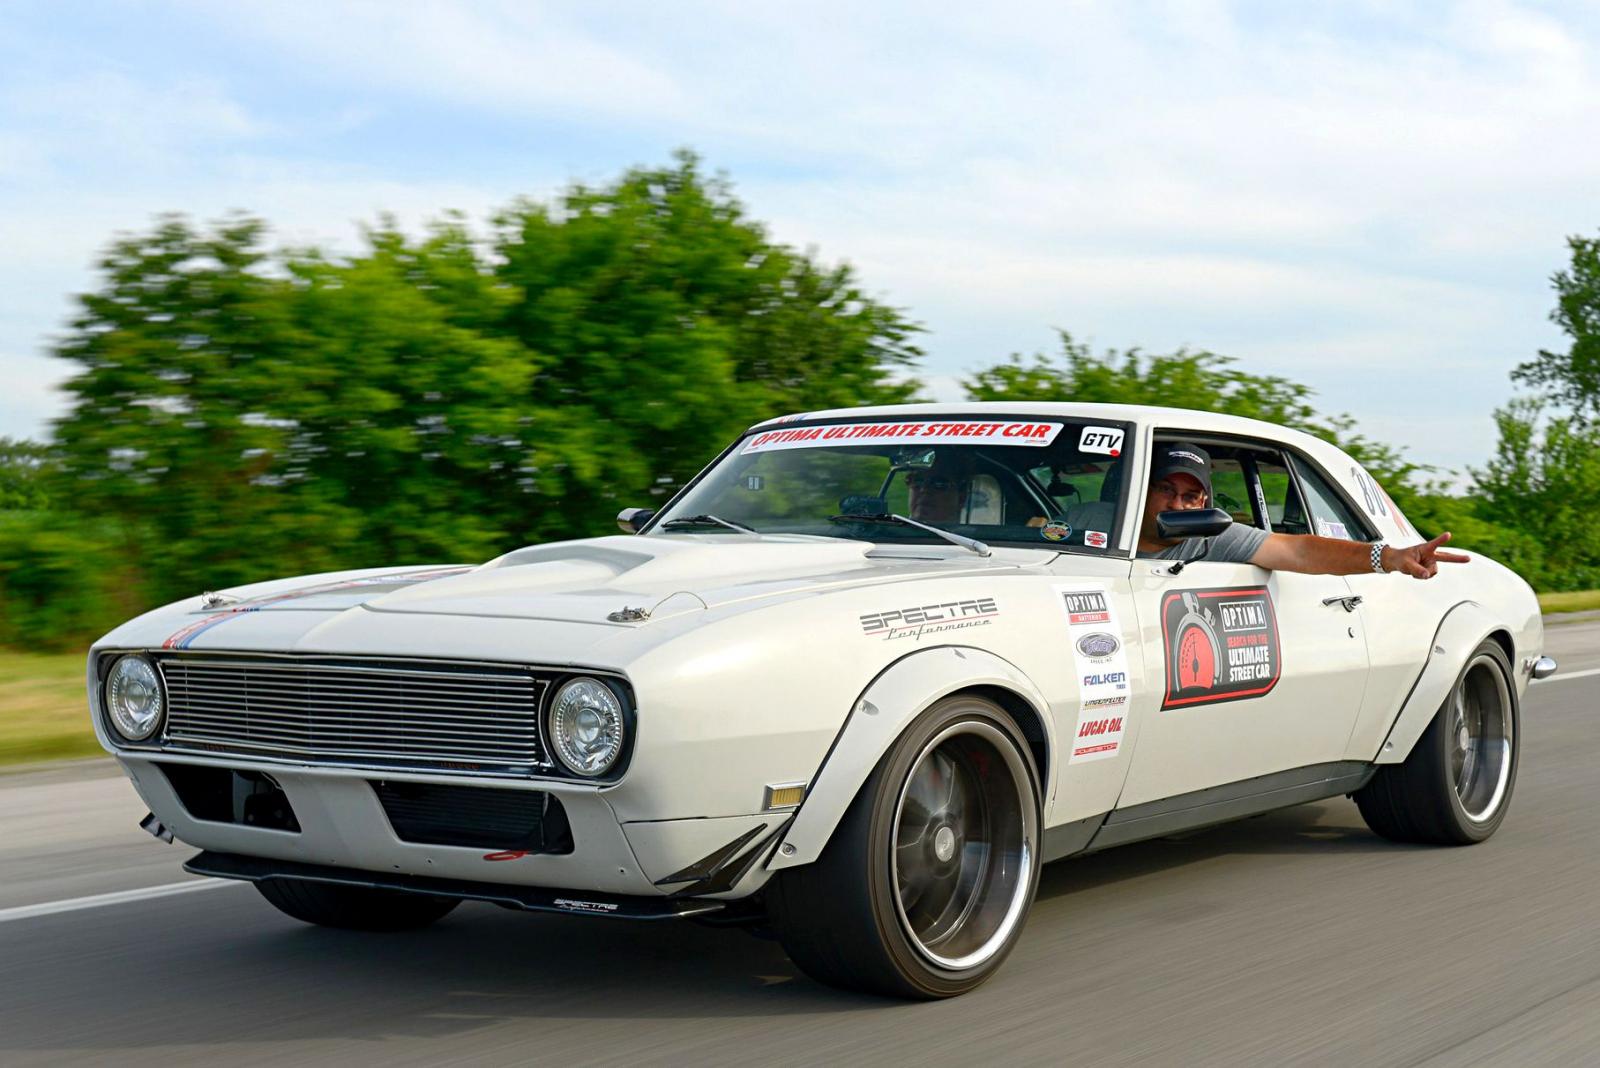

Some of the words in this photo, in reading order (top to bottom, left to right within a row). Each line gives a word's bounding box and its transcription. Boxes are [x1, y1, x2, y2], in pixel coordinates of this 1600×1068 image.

[751, 428, 825, 447] OPTIMA
[822, 423, 919, 440] ULTIMATE
[921, 423, 999, 437] STREET
[1002, 424, 1052, 438] CAR
[1082, 432, 1120, 449] GTV
[1066, 594, 1106, 612] OPTIMA
[860, 598, 998, 631] SPECTRE
[1222, 606, 1264, 627] OPTIMA
[883, 620, 991, 641] Performance
[1228, 646, 1270, 666] ULTIMATE
[1084, 672, 1126, 686] FALKEN
[1230, 665, 1255, 682] STREET
[1255, 664, 1270, 678] CAR
[1079, 718, 1108, 738] LUCAS
[1108, 717, 1123, 733] OIL
